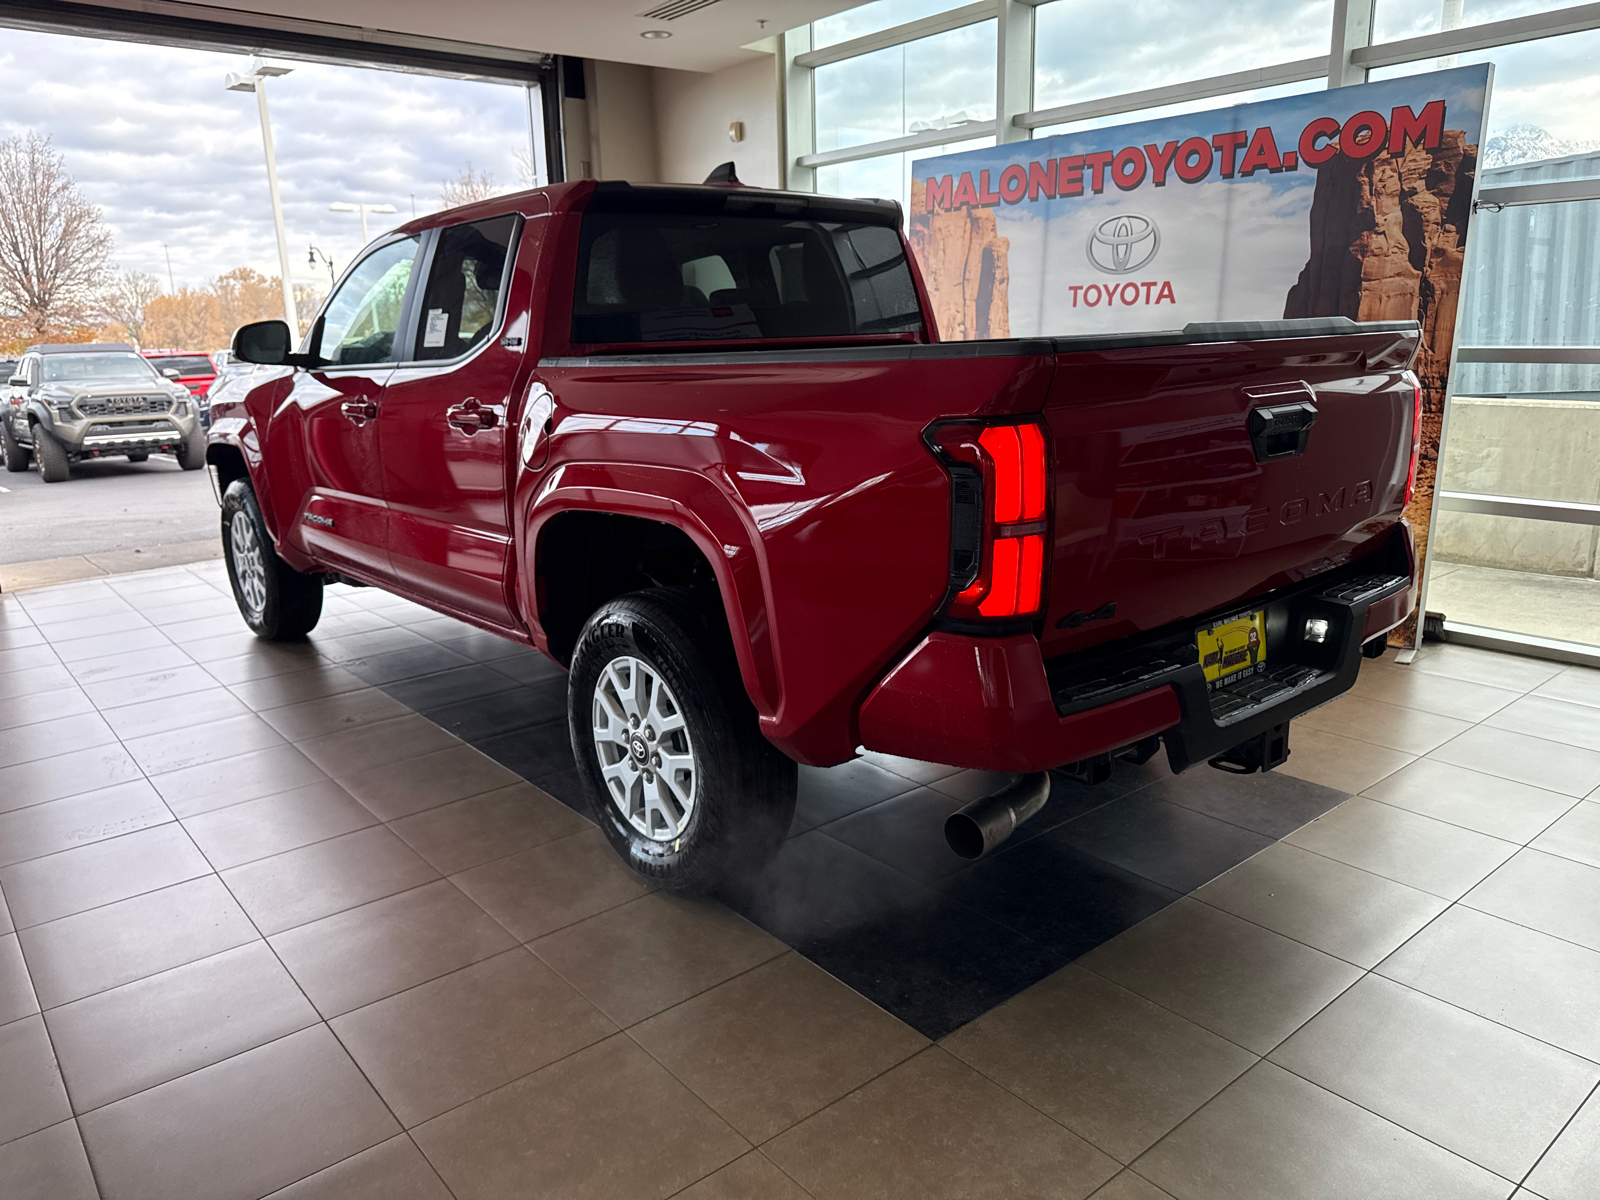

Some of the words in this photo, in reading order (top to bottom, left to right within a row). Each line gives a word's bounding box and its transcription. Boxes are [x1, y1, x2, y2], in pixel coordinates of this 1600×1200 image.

[926, 100, 1447, 211] MALONETOYOTA.COM
[1068, 281, 1176, 308] TOYOTA
[109, 396, 145, 406] TOYOTA
[303, 512, 335, 527] TACOMA
[1138, 479, 1374, 559] TACOMA
[1250, 631, 1257, 642] 32
[1215, 680, 1223, 689] WE
[1224, 674, 1237, 686] MAKE
[1237, 671, 1242, 680] IT
[1242, 667, 1254, 678] EASY
